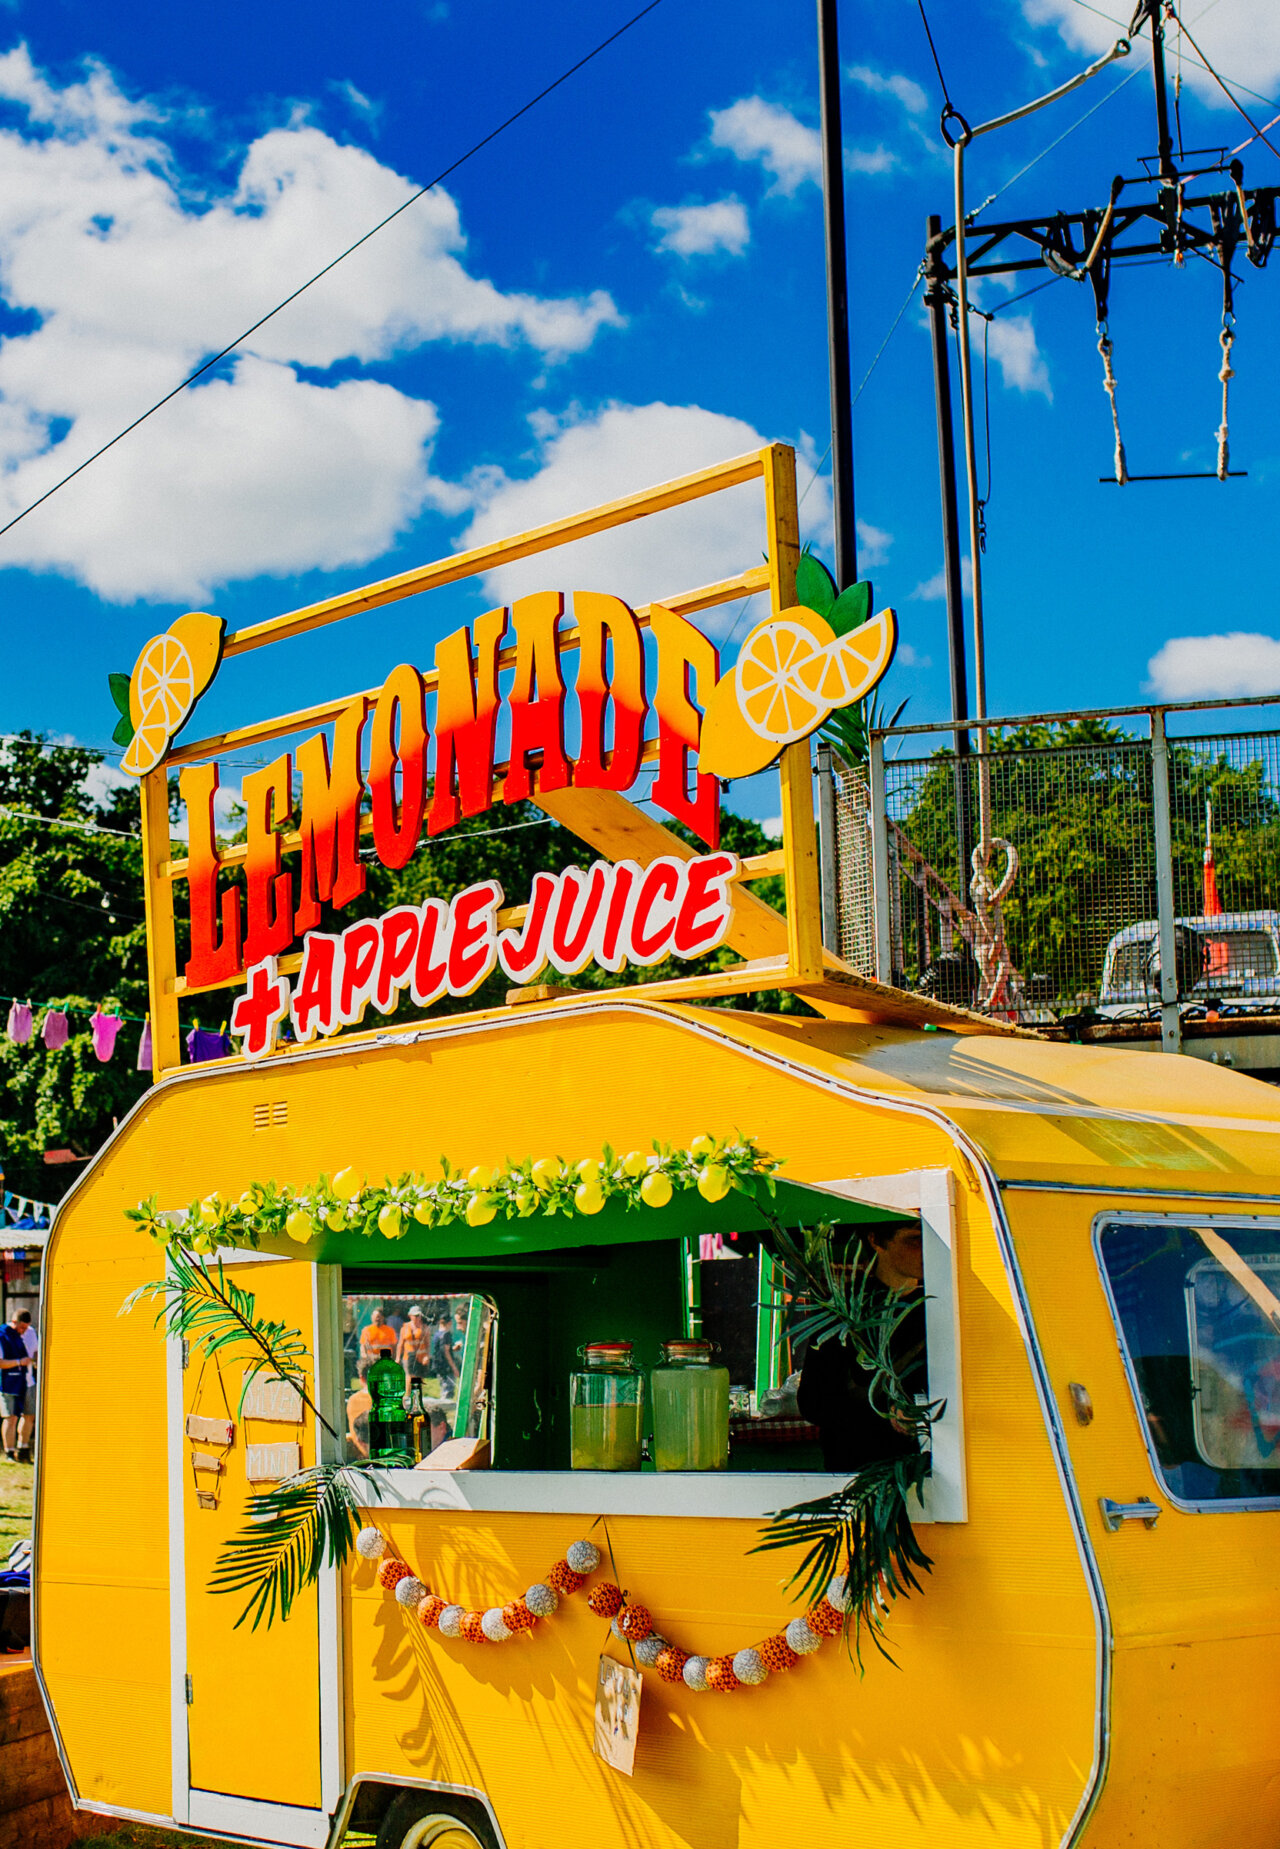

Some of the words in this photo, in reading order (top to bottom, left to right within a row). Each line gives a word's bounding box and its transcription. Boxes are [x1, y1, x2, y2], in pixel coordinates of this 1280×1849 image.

[179, 591, 721, 987] LEMONADE
[292, 882, 500, 1037] APPLE
[500, 853, 736, 979] JUICE
